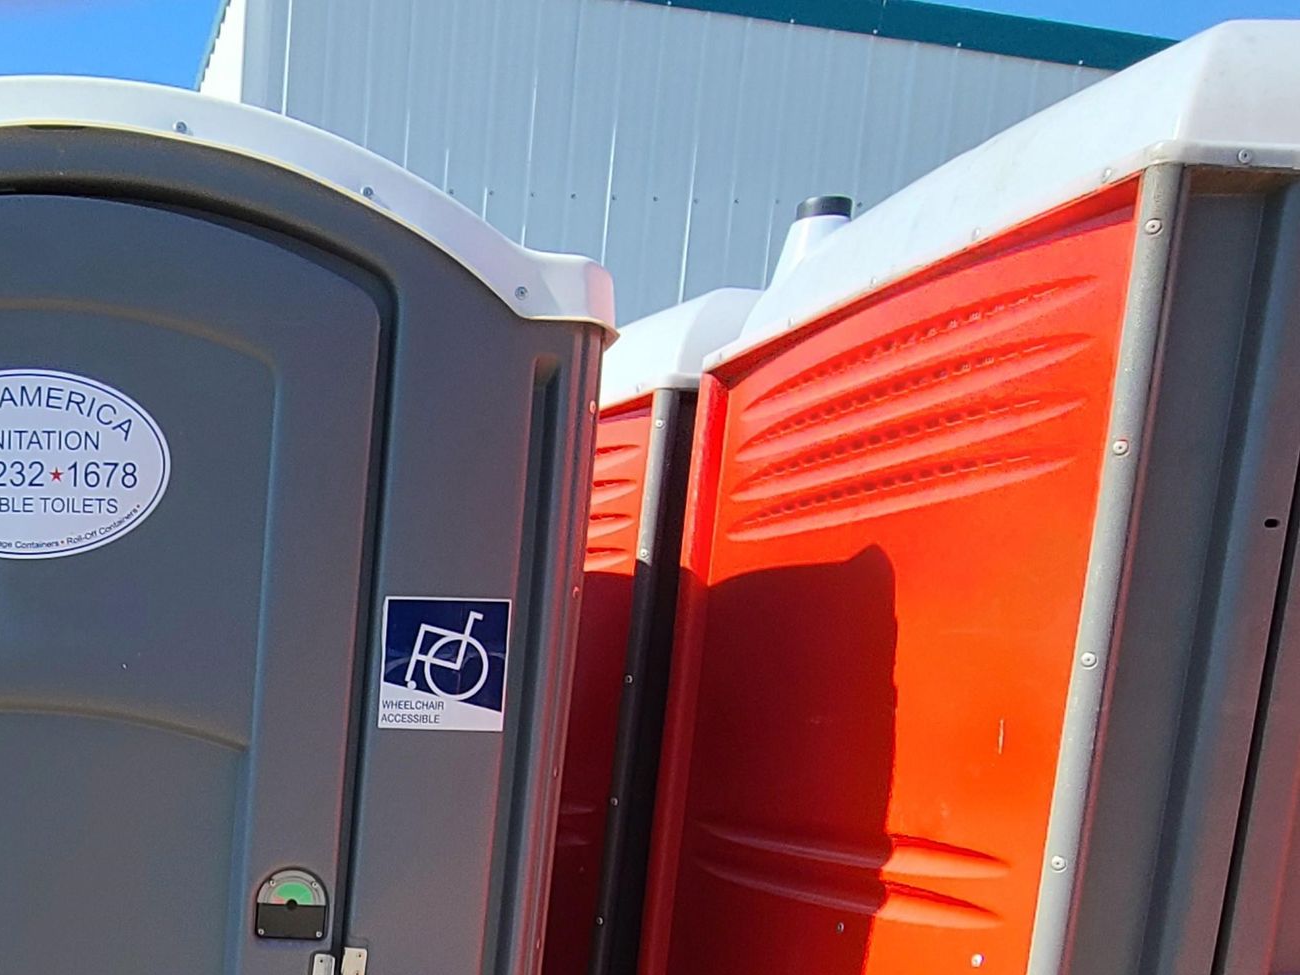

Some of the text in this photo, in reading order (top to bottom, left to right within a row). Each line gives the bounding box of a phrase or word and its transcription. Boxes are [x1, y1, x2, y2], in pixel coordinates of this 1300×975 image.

[67, 461, 138, 489] 1678
[40, 498, 119, 514] TOILETS
[15, 539, 60, 549] Containers
[66, 530, 98, 546] Roll-Off
[98, 508, 139, 537] Containers
[382, 700, 444, 710] WHEELCHAIR
[380, 713, 440, 724] ACCESSIBLE
